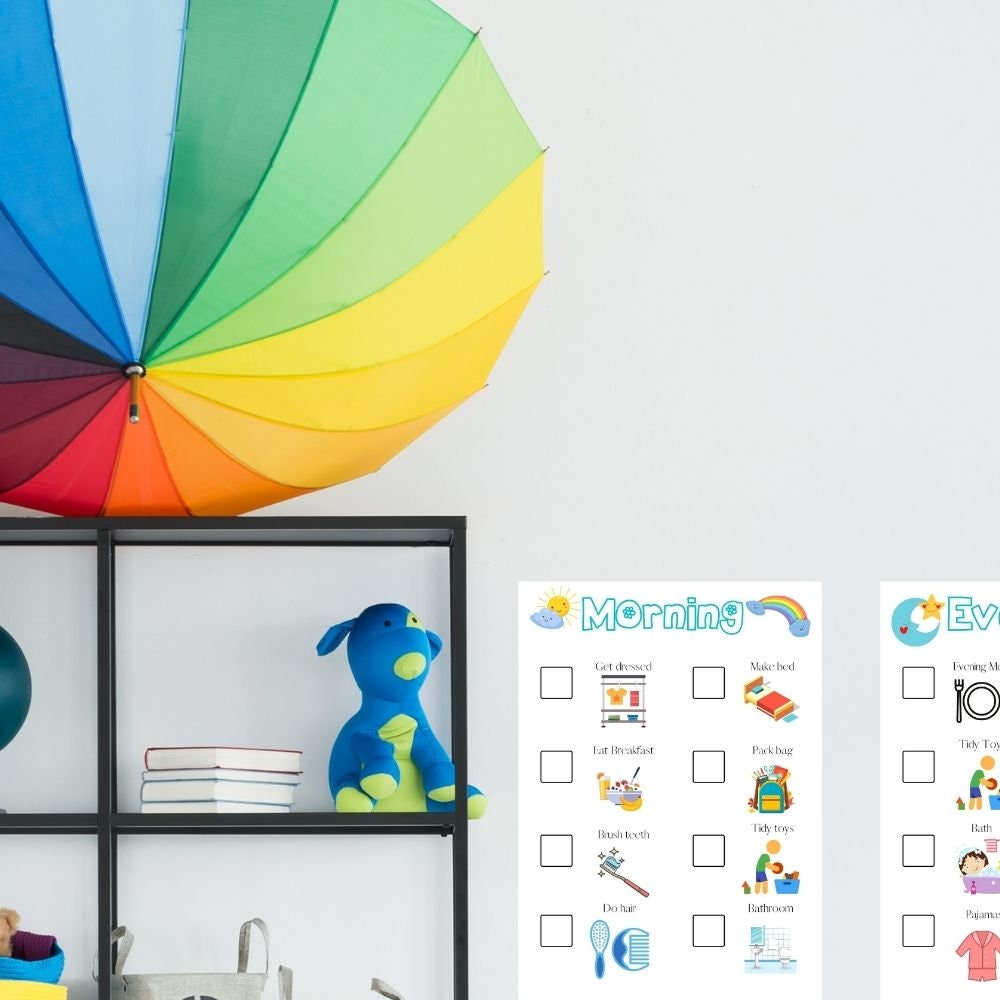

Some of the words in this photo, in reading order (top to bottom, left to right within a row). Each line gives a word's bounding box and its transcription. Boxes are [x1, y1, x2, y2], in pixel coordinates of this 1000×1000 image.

[582, 596, 744, 636] Morning
[595, 661, 614, 672] Get
[616, 661, 652, 672] dressed
[750, 661, 774, 672] Make
[776, 661, 795, 672] bed
[953, 661, 987, 673] Evening
[593, 745, 609, 756] Eat
[611, 745, 655, 756] Breakfast
[958, 739, 980, 751] Tidy
[752, 745, 774, 756] Pack
[775, 745, 794, 758] bag
[750, 823, 772, 835] Tidy
[774, 823, 794, 835] toys
[971, 823, 992, 833] Bath
[598, 829, 622, 840] Brush
[624, 829, 650, 840] teeth
[602, 903, 618, 914] Do
[620, 903, 637, 914] hair
[748, 903, 794, 914] Bathroom
